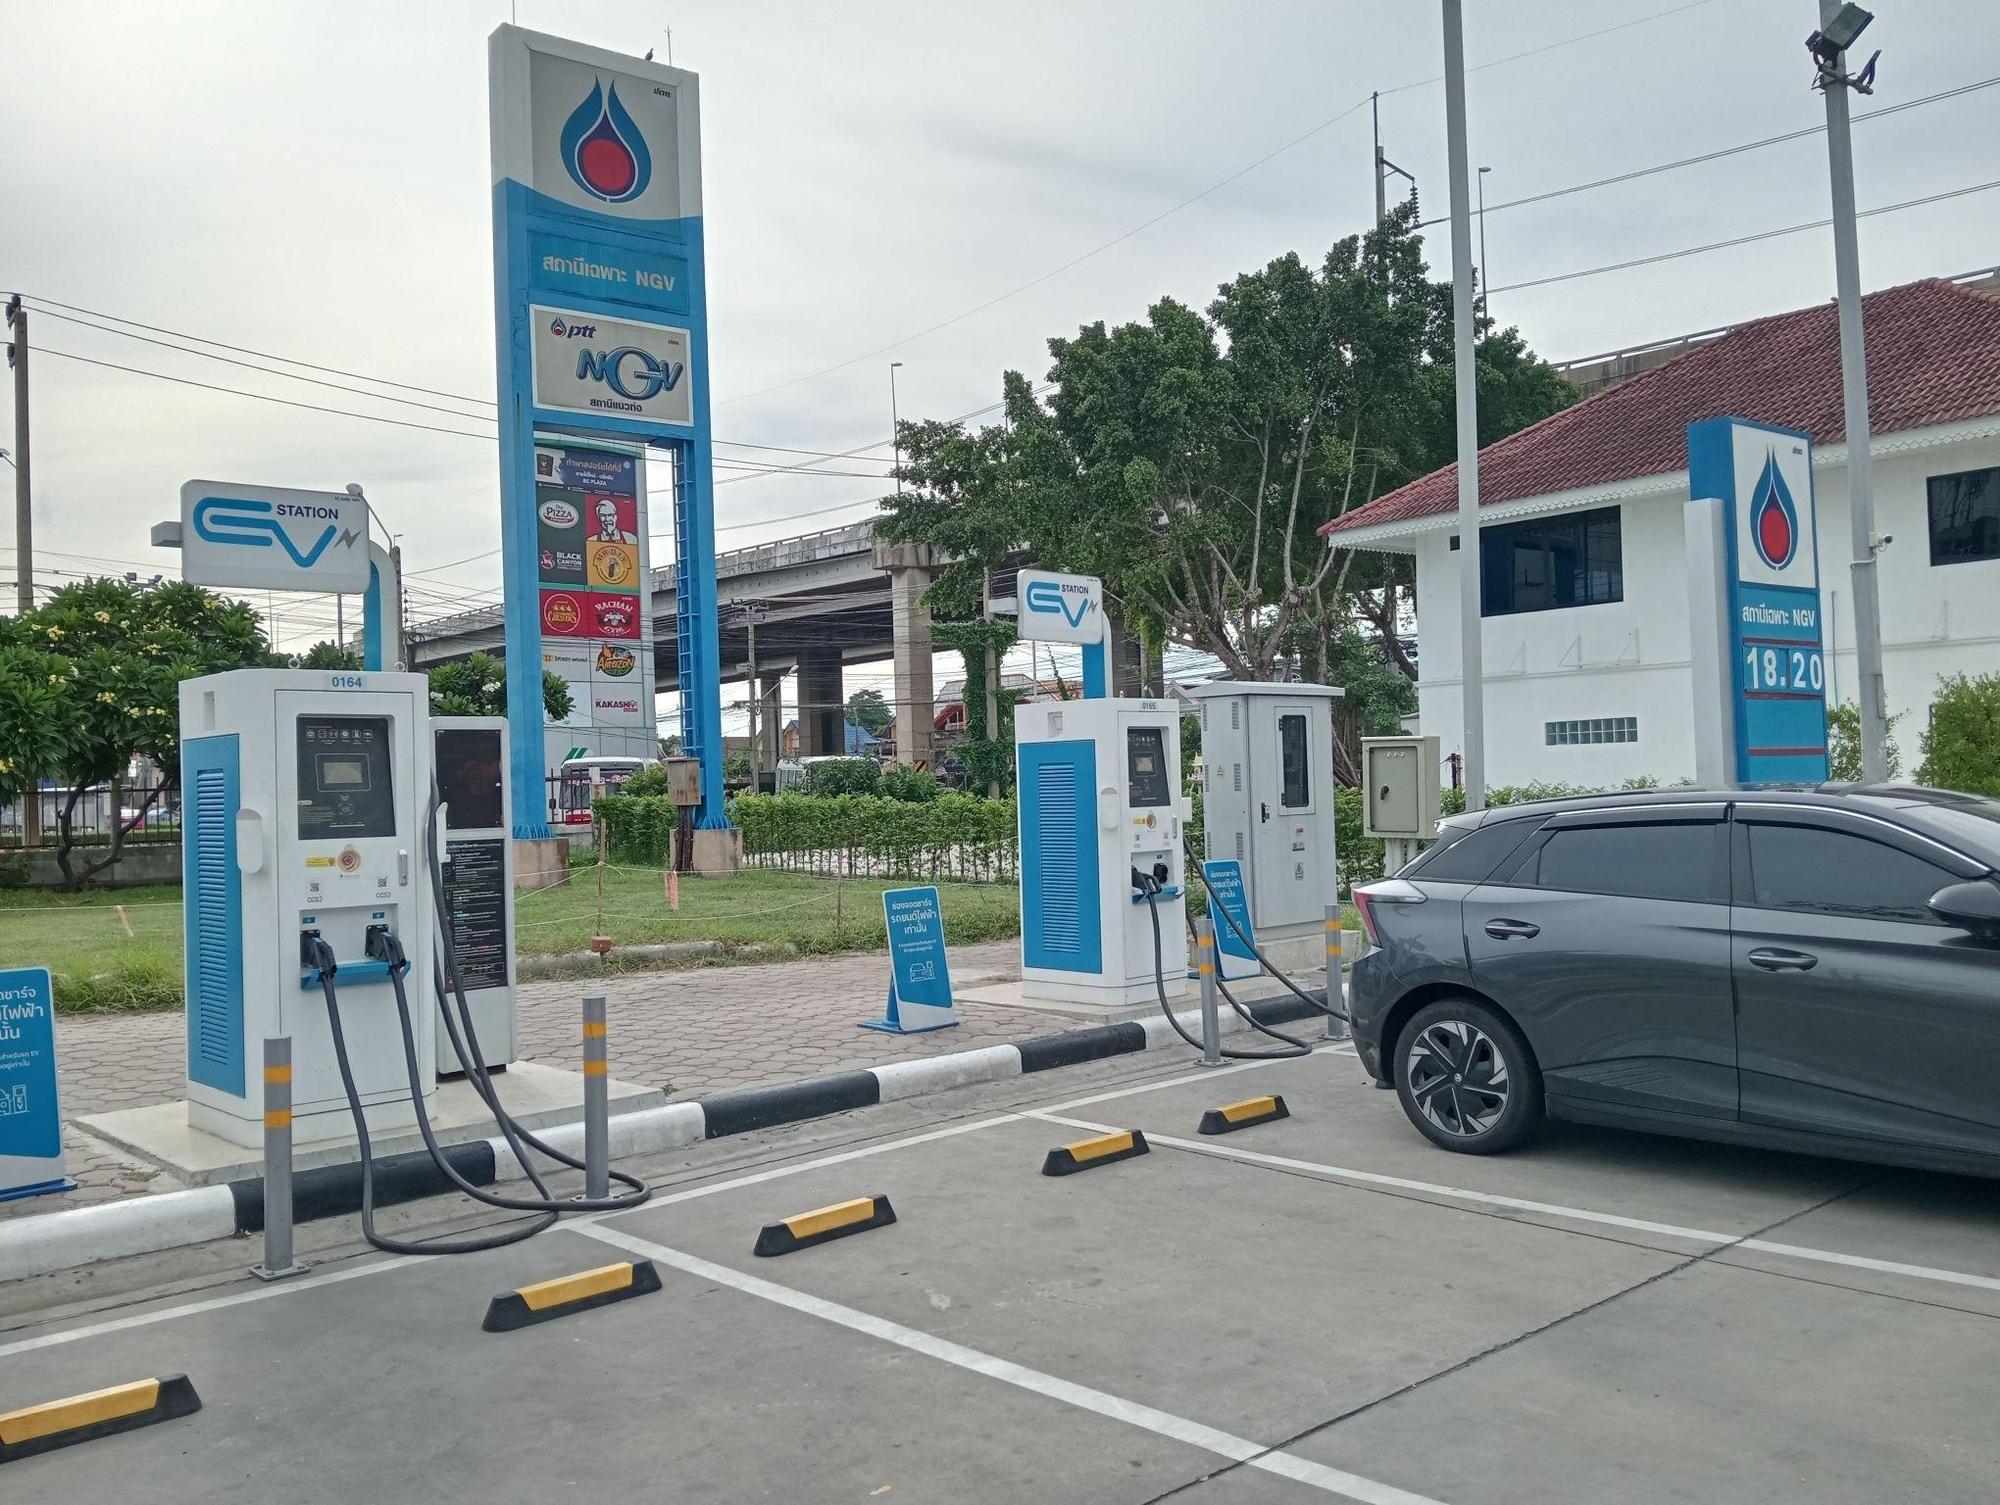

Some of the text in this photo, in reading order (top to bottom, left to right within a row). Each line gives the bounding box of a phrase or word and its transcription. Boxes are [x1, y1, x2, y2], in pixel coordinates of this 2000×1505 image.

[543, 255, 675, 292] สถานีเฉพาะ NGV
[567, 323, 596, 339] ptt
[576, 346, 684, 401] NGV
[276, 504, 339, 520] STATION
[193, 496, 337, 568] EV
[556, 551, 582, 561] BLACK
[556, 558, 582, 566] CANYON
[1061, 584, 1089, 594] STATION
[1026, 581, 1088, 628] EV
[1742, 604, 1815, 627] สถานีเฉพาะ NGV
[1747, 647, 1823, 690] 18.20
[332, 676, 362, 688] 0164
[890, 909, 937, 923] รถยนต์ไฟฟ้า
[904, 920, 928, 935] เท่านั้น
